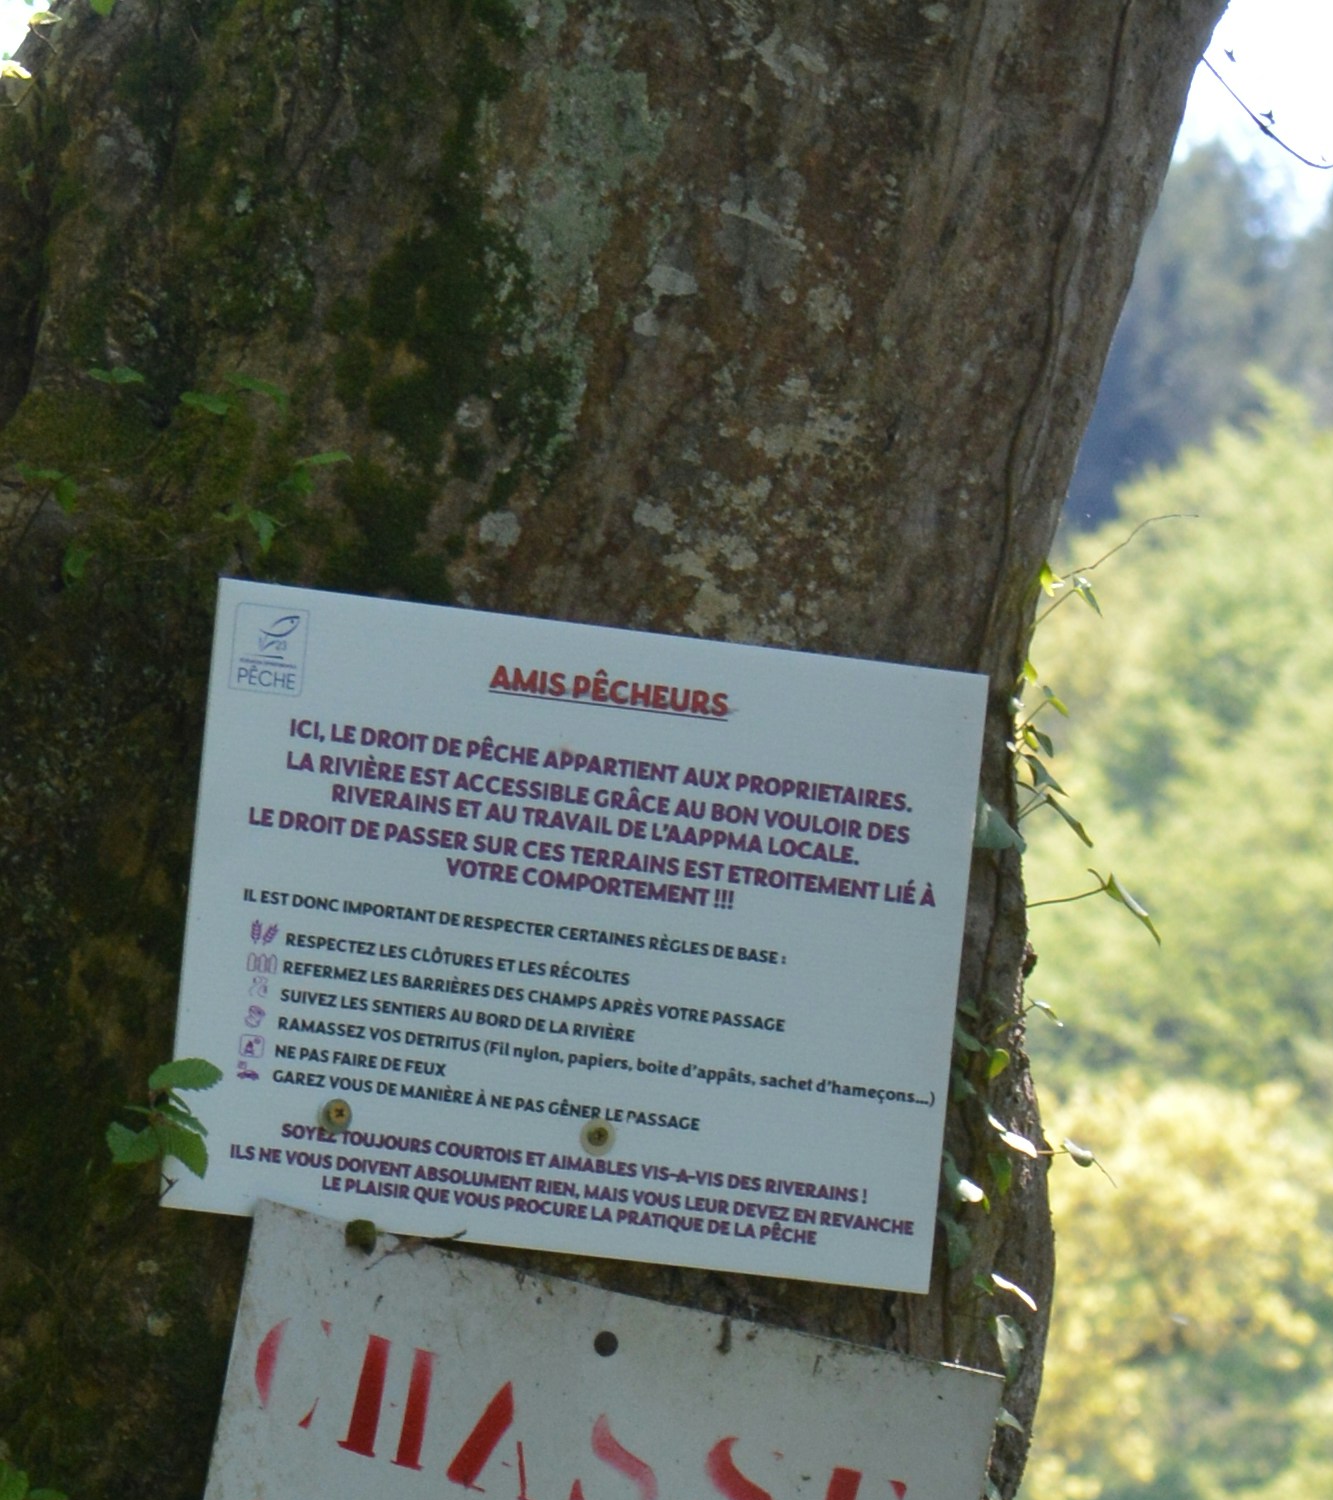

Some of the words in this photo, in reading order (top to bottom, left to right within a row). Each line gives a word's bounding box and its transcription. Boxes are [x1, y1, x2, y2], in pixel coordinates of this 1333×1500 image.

[237, 665, 296, 690] PÊCHE
[491, 665, 565, 696] AMIS
[571, 670, 728, 715] PÊCHEURS
[287, 751, 314, 772] LA
[320, 756, 405, 782] RIVIÈRE
[411, 767, 450, 787] EST
[454, 772, 589, 805] ACCESSIBLE
[594, 787, 670, 815] GRÂCE
[674, 799, 705, 819] AU
[712, 803, 758, 825] BON
[765, 810, 862, 838] VOULOIR
[868, 823, 910, 844] DES
[290, 719, 325, 742] ICI,
[331, 724, 356, 744] LE
[361, 728, 428, 752] DROIT
[433, 736, 462, 757] DE
[467, 736, 539, 766] PÊCHE
[543, 750, 679, 783] APPARTIENT
[683, 768, 731, 790] AUX
[736, 774, 912, 812] PROPRIETAIRES.
[249, 807, 274, 827] LE
[279, 811, 346, 835] DROIT
[351, 819, 379, 840] DE
[384, 824, 467, 850] PASSER
[474, 835, 517, 856] SUR
[523, 841, 565, 862] CES
[571, 846, 679, 875] TERRAINS
[685, 860, 724, 880] EST
[728, 865, 880, 899] ETROITEMENT
[884, 880, 915, 904] LIÉ
[920, 882, 935, 907] À
[332, 784, 451, 815] RIVERAINS
[456, 799, 482, 819] ET
[485, 803, 516, 823] AU
[523, 808, 612, 835] TRAVAIL
[618, 819, 646, 839] DE
[652, 824, 763, 853] L'AAPPMA
[768, 837, 859, 865] LOCALE.
[447, 858, 518, 883] VOTRE
[523, 868, 710, 906] COMPORTEMENT
[714, 889, 734, 909] !!!
[244, 889, 256, 902] IL
[261, 891, 289, 905] EST
[292, 894, 339, 911] DONC
[343, 901, 436, 923] IMPORTANT
[439, 912, 460, 926] DE
[463, 915, 554, 937] RESPECTER
[558, 927, 645, 948] CERTAINES
[649, 934, 708, 956] RÈGLES
[713, 945, 734, 959] DE
[737, 948, 778, 964] BASE
[286, 933, 375, 956] RESPECTEZ
[380, 944, 406, 959] LES
[411, 947, 493, 969] CLÔTURES
[497, 958, 515, 971] ET
[519, 961, 546, 976] LES
[550, 961, 629, 985] RÉCOLTES
[281, 989, 337, 1007] SUIVEZ
[341, 996, 368, 1011] LES
[372, 1000, 446, 1020] SENTIERS
[450, 1009, 472, 1023] AU
[476, 1012, 521, 1029] BORD
[525, 1018, 545, 1032] DE
[550, 1021, 568, 1035] LA
[573, 1023, 635, 1042] RIVIÈRE
[283, 961, 367, 983] REFERMEZ
[371, 971, 397, 986] LES
[402, 975, 489, 997] BARRIÈRES
[494, 986, 524, 1001] DES
[528, 990, 596, 1009] CHAMPS
[601, 998, 652, 1016] APRÈS
[658, 1005, 709, 1023] VOTRE
[712, 1012, 785, 1032] PASSAGE
[275, 1045, 296, 1059] NE
[299, 1048, 329, 1063] PAS
[333, 1051, 377, 1068] FAIRE
[381, 1057, 401, 1071] DE
[405, 1060, 446, 1076] FEUX
[278, 1017, 365, 1039] RAMASSEZ
[370, 1028, 401, 1043] VOS
[405, 1032, 480, 1052] DETRITUS
[484, 1040, 509, 1056] (Fil
[513, 1046, 563, 1063] nylon,
[568, 1053, 632, 1071] papiers,
[682, 1064, 755, 1085] d'appâts,
[760, 1075, 812, 1091] sachet
[273, 1070, 325, 1088] GAREZ
[330, 1076, 372, 1093] VOUS
[377, 1082, 397, 1096] DE
[401, 1085, 473, 1104] MANIÈRE
[476, 1089, 486, 1106] À
[491, 1095, 512, 1109] NE
[515, 1098, 544, 1113] PAS
[548, 1099, 600, 1119] GÊNER
[606, 1109, 623, 1122] LE
[230, 1144, 255, 1160] ILS
[259, 1148, 282, 1163] NE
[286, 1150, 332, 1169] VOUS
[337, 1157, 411, 1178] DOIVENT
[414, 1166, 532, 1191] ABSOLUMENT
[536, 1179, 579, 1199] RIEN,
[585, 1185, 628, 1203] MAIS
[633, 1190, 680, 1209] VOUS
[686, 1197, 728, 1214] LEUR
[733, 1202, 788, 1222] DEVEZ
[794, 1209, 815, 1224] EN
[820, 1212, 914, 1235] REVANCHE
[340, 1131, 431, 1154] TOUJOURS
[435, 1141, 522, 1164] COURTOIS
[526, 1151, 546, 1167] ET
[548, 1154, 637, 1177] AIMABLES
[642, 1165, 723, 1187] VIS-A-VIS
[728, 1174, 761, 1191] DES
[765, 1179, 858, 1202] RIVERAINS
[322, 1176, 341, 1191] LE
[345, 1178, 409, 1199] PLAISIR
[414, 1187, 449, 1204] QUE
[454, 1191, 500, 1209] VOUS
[504, 1197, 587, 1219] PROCURE
[591, 1206, 612, 1222] LA
[617, 1209, 703, 1233] PRATIQUE
[708, 1220, 730, 1235] DE
[734, 1223, 756, 1238] LA
[760, 1222, 817, 1245] PÊCHE
